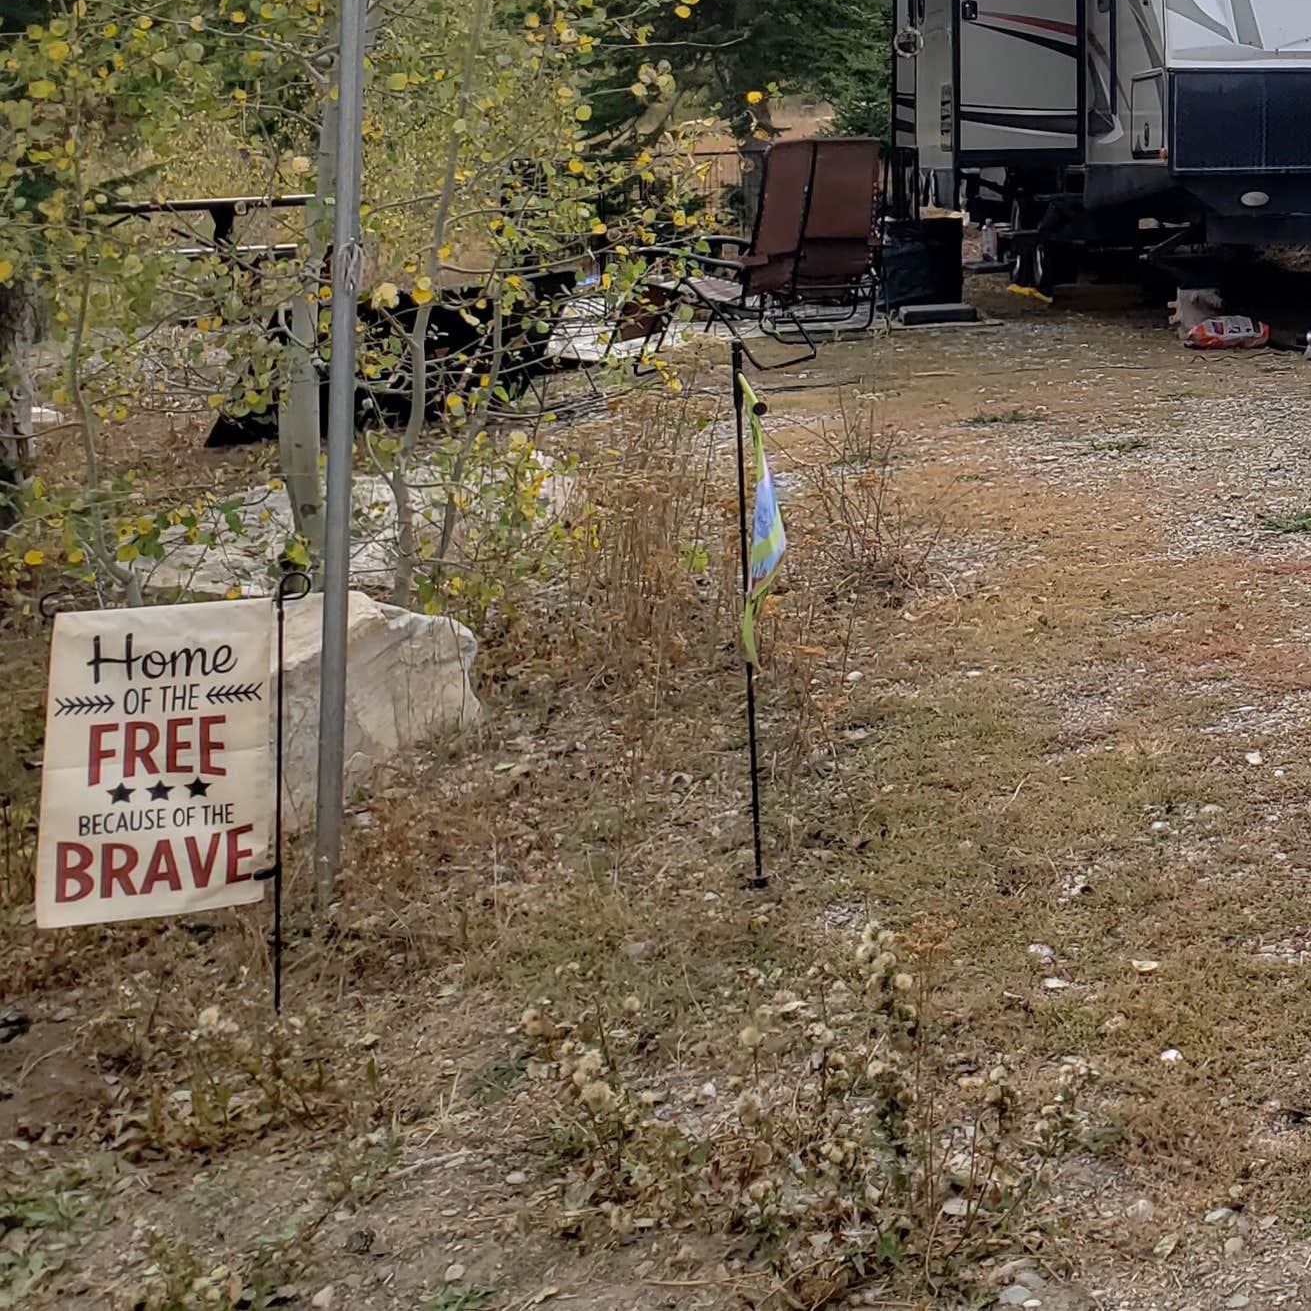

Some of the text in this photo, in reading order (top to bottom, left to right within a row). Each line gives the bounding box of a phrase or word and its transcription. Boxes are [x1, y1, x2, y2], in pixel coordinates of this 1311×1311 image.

[86, 632, 239, 685] Home
[123, 683, 200, 715] OF THE
[87, 714, 228, 788] FREE
[78, 802, 235, 838] BECAUSE OF THE
[54, 822, 255, 904] BRAVE
